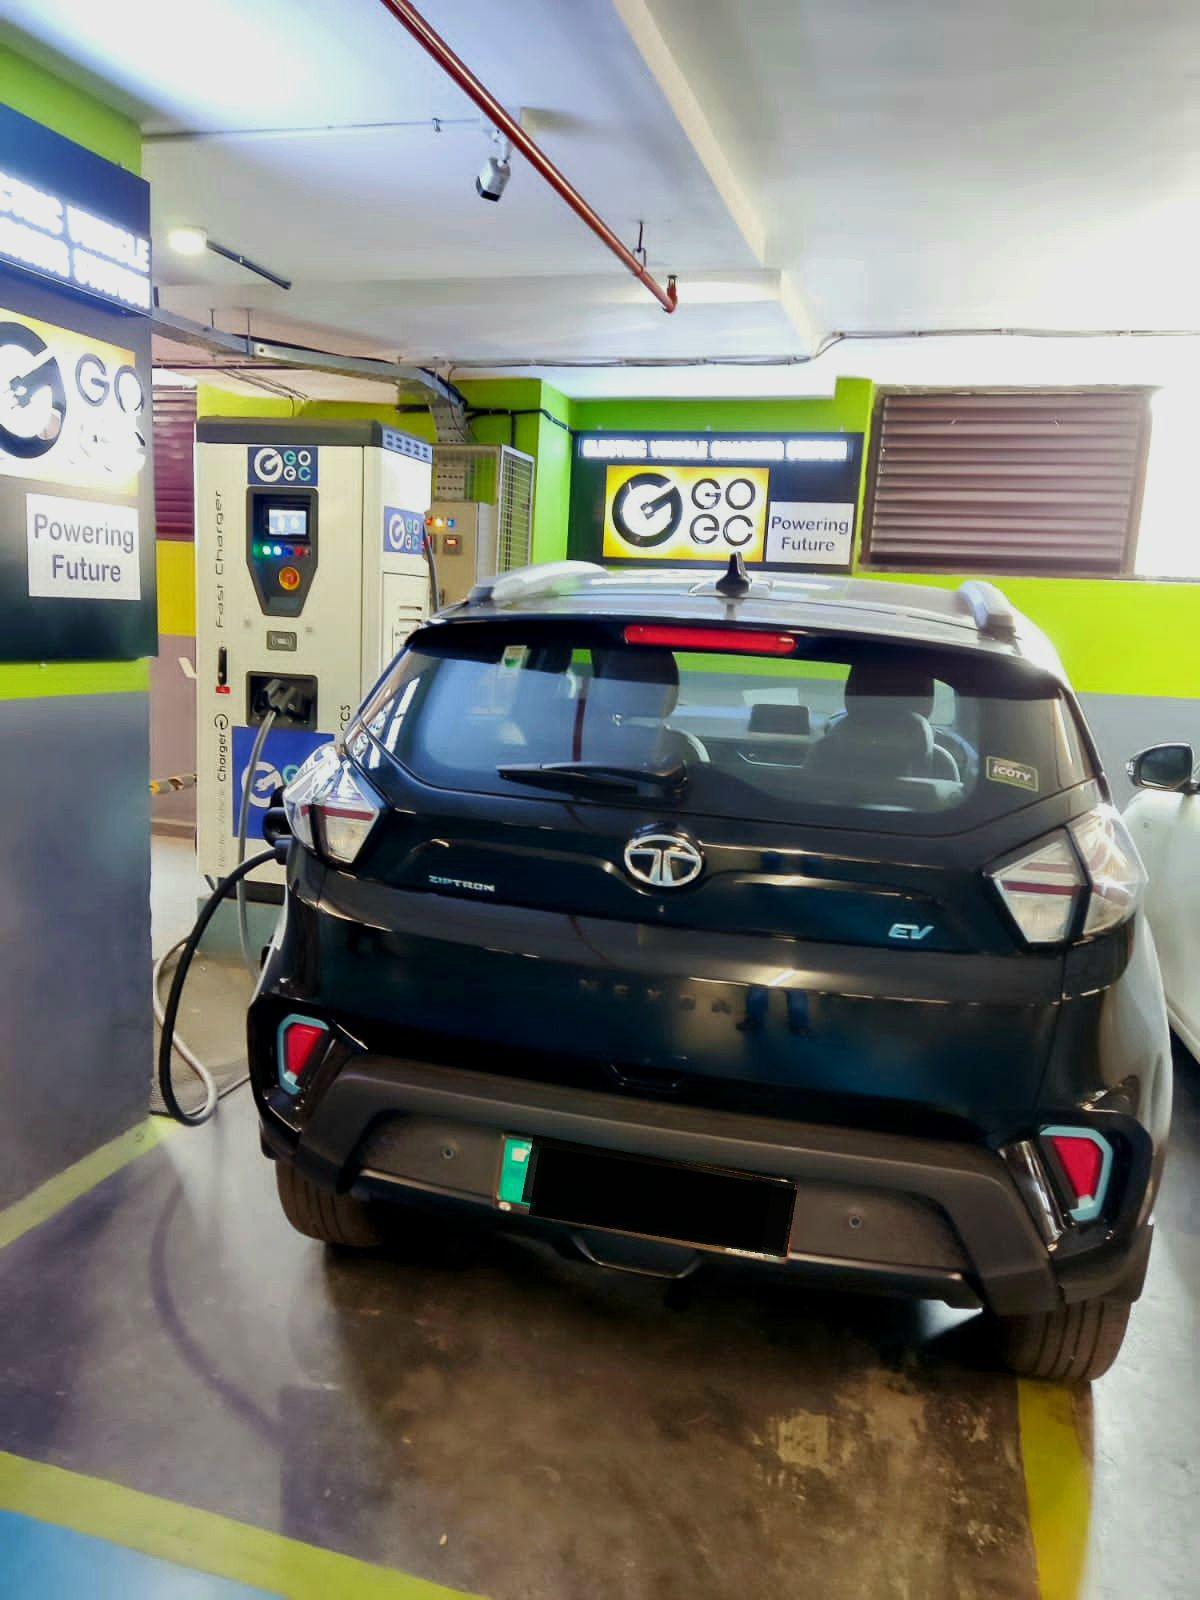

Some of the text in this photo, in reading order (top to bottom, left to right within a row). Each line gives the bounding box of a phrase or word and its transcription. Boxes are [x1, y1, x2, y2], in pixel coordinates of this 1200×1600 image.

[691, 478, 756, 510] GO
[34, 513, 134, 554] Powering
[771, 515, 849, 535] Powering
[781, 536, 835, 551] Future
[52, 554, 121, 582] Future
[215, 490, 224, 628] Fast Charger
[216, 733, 228, 782] Charger
[888, 923, 935, 940] EV
